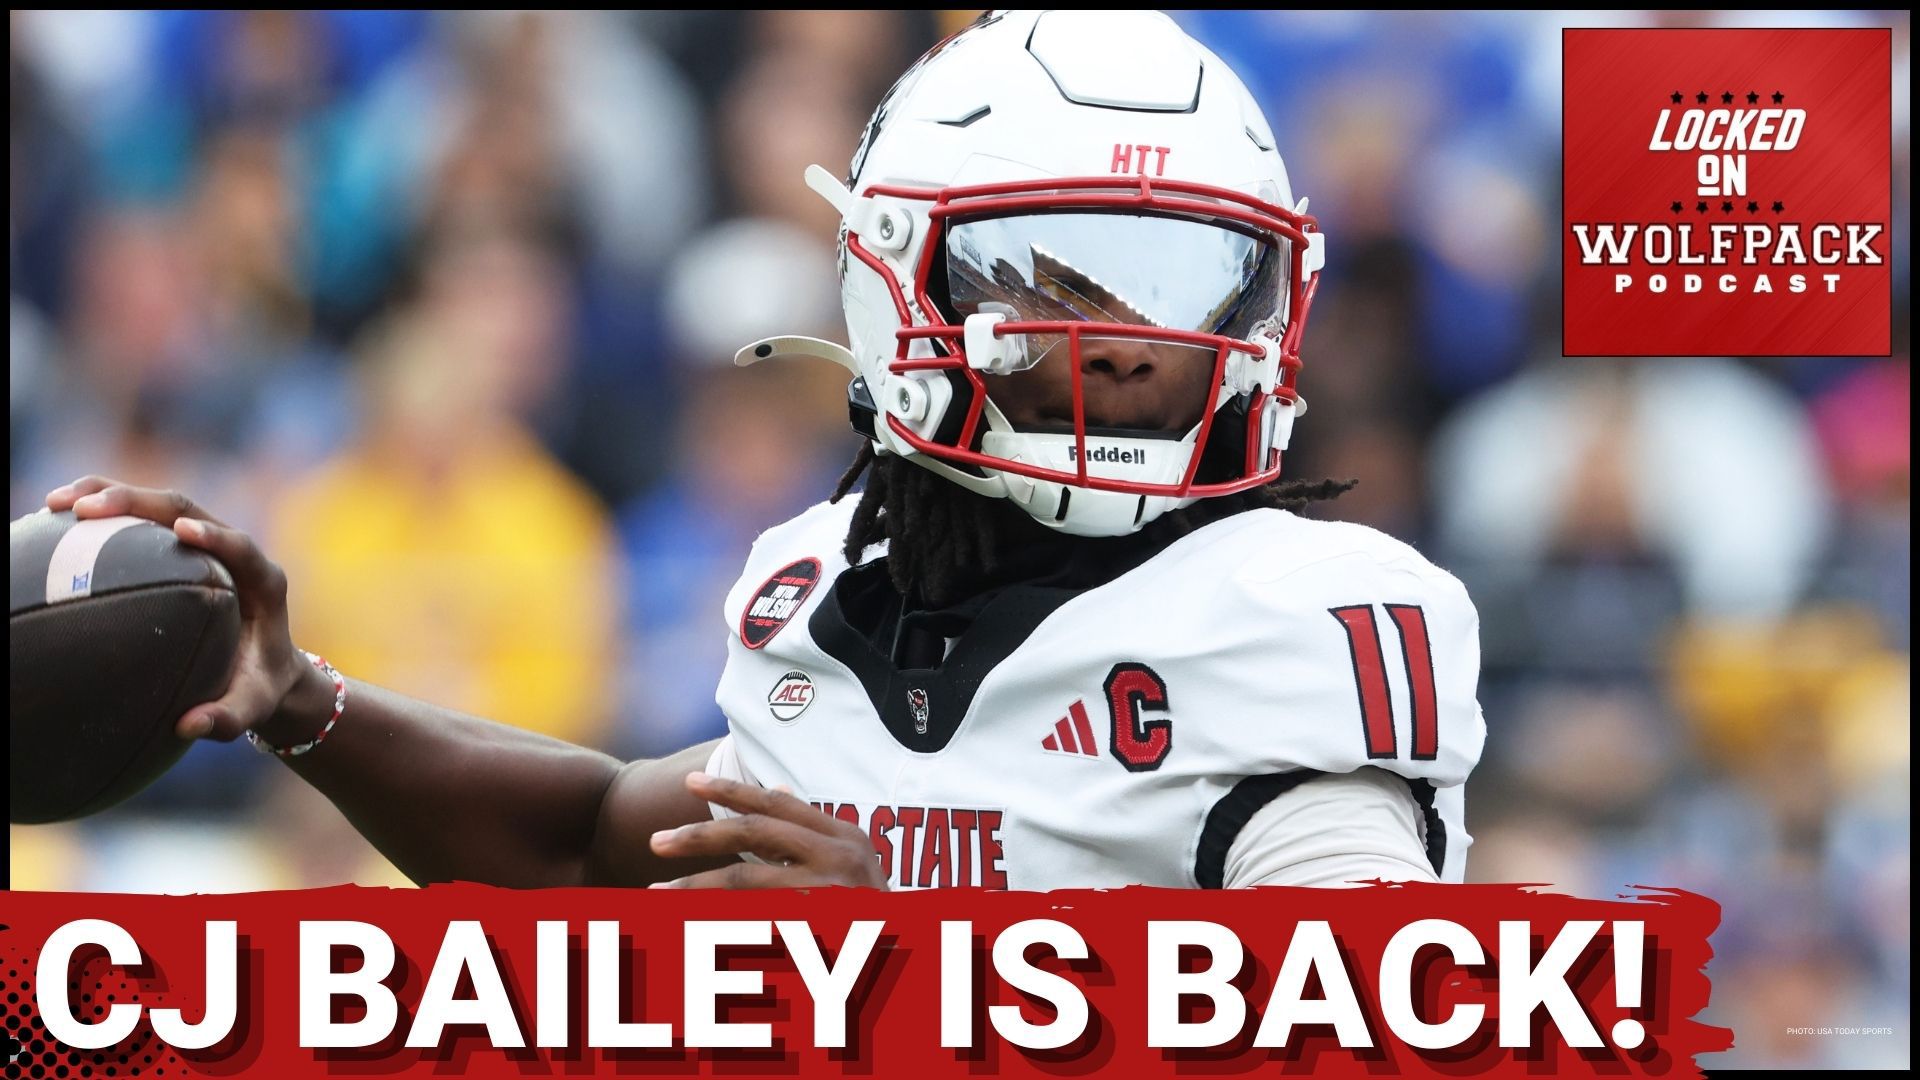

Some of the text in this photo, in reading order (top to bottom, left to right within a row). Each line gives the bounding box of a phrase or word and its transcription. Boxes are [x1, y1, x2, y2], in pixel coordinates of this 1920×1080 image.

[1111, 144, 1170, 176] HTT
[749, 596, 800, 619] WILSON
[776, 684, 812, 702] ACC
[1328, 604, 1439, 760] 11
[1103, 662, 1172, 772] C
[869, 805, 1008, 890] STATE
